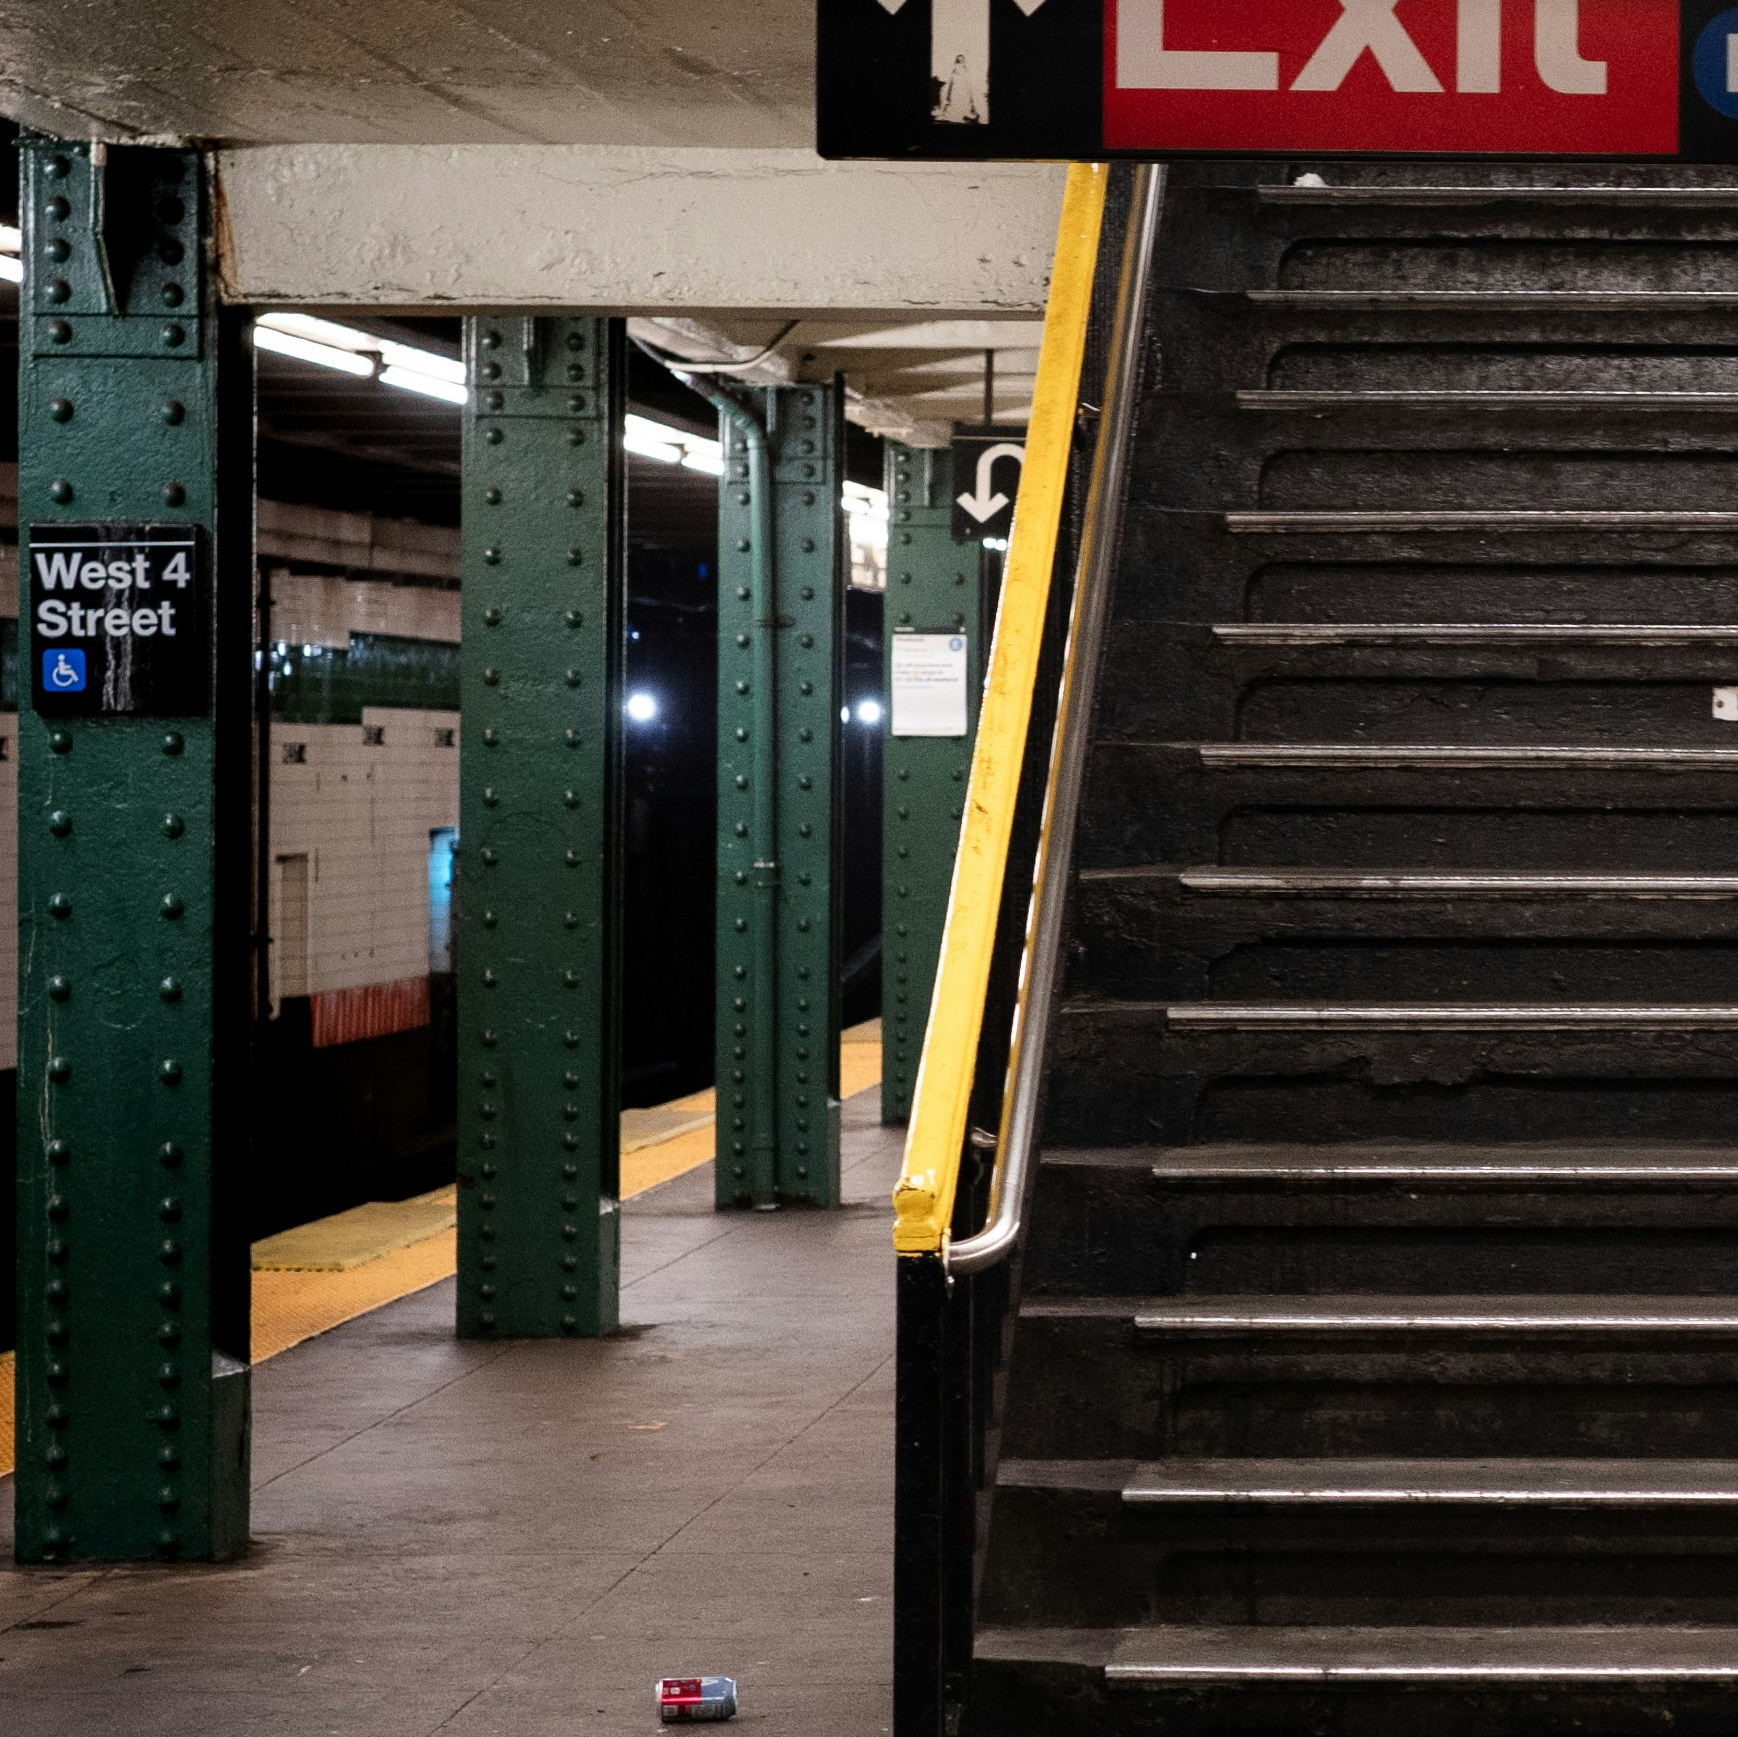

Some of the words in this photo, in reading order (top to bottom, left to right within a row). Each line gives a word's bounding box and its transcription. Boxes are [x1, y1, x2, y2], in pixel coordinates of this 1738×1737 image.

[34, 551, 151, 591] West
[161, 551, 191, 589] 4
[36, 598, 177, 639] Street
